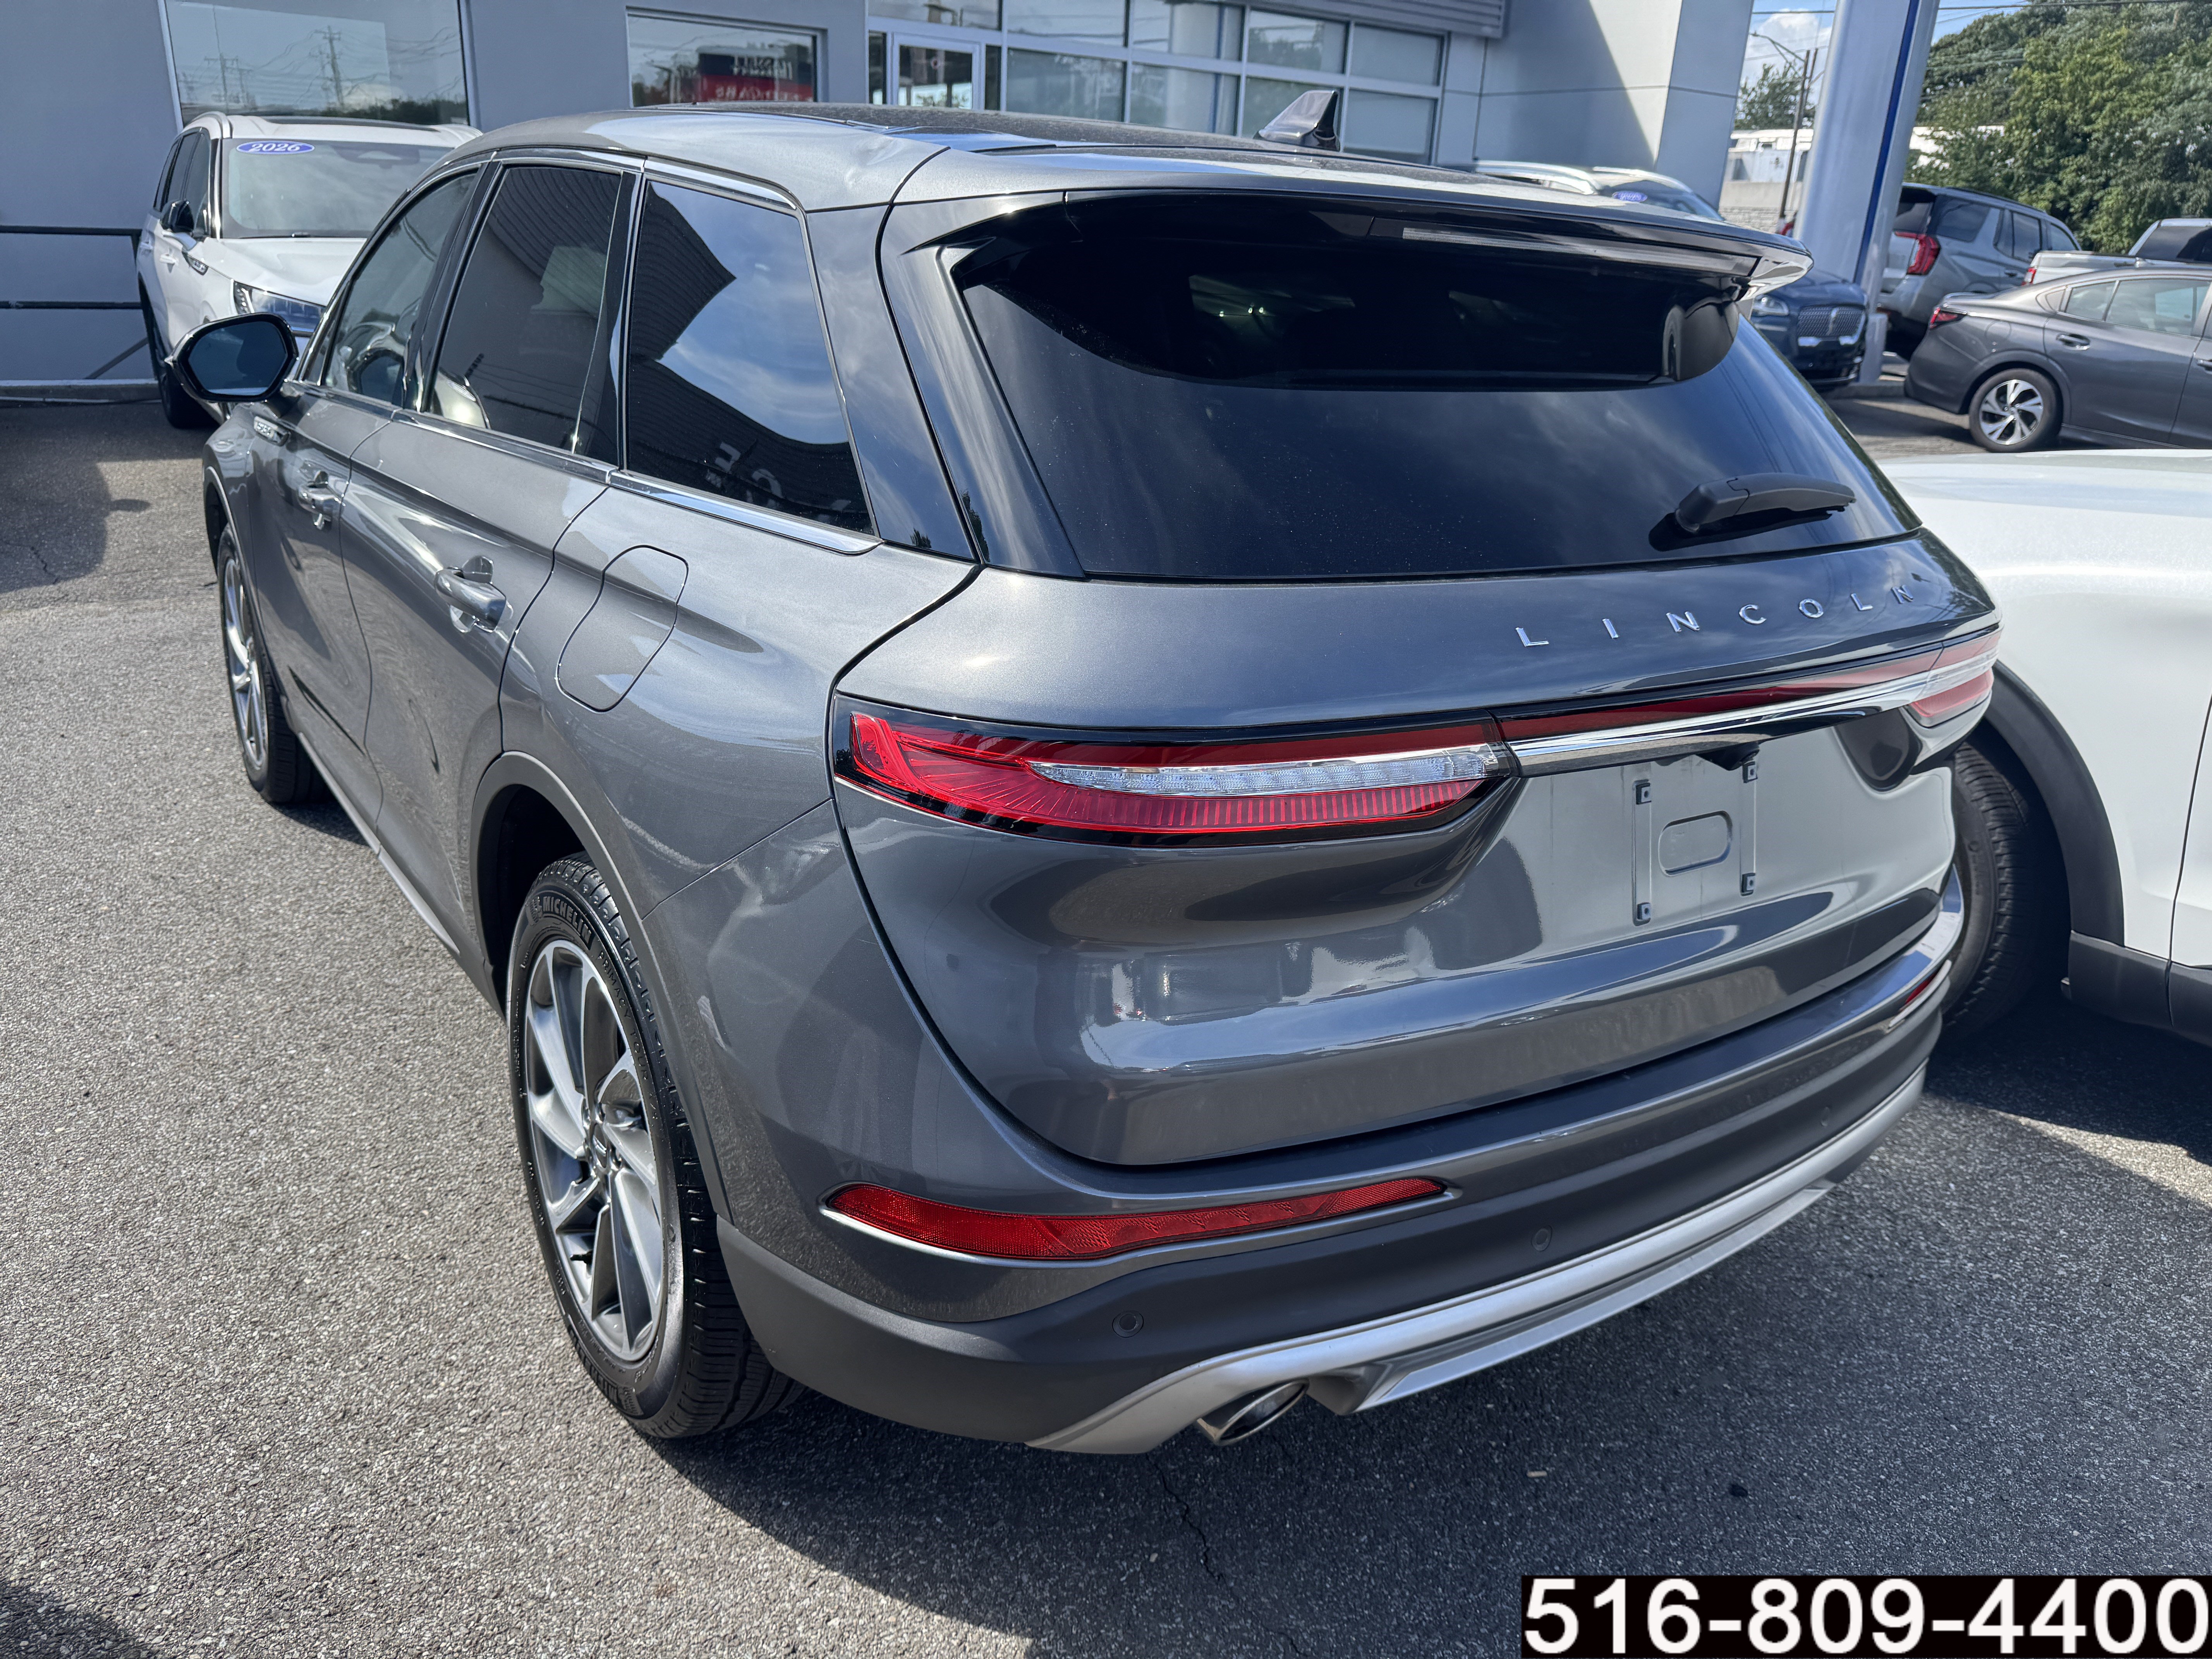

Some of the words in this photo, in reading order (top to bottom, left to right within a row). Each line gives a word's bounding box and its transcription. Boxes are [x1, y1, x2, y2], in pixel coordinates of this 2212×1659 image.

[248, 143, 304, 152] 2026
[1515, 584, 1914, 647] LINCOLN
[543, 896, 591, 942] MICHELIN
[598, 950, 632, 1019] PRIMACY
[630, 1028, 649, 1080] TOUR
